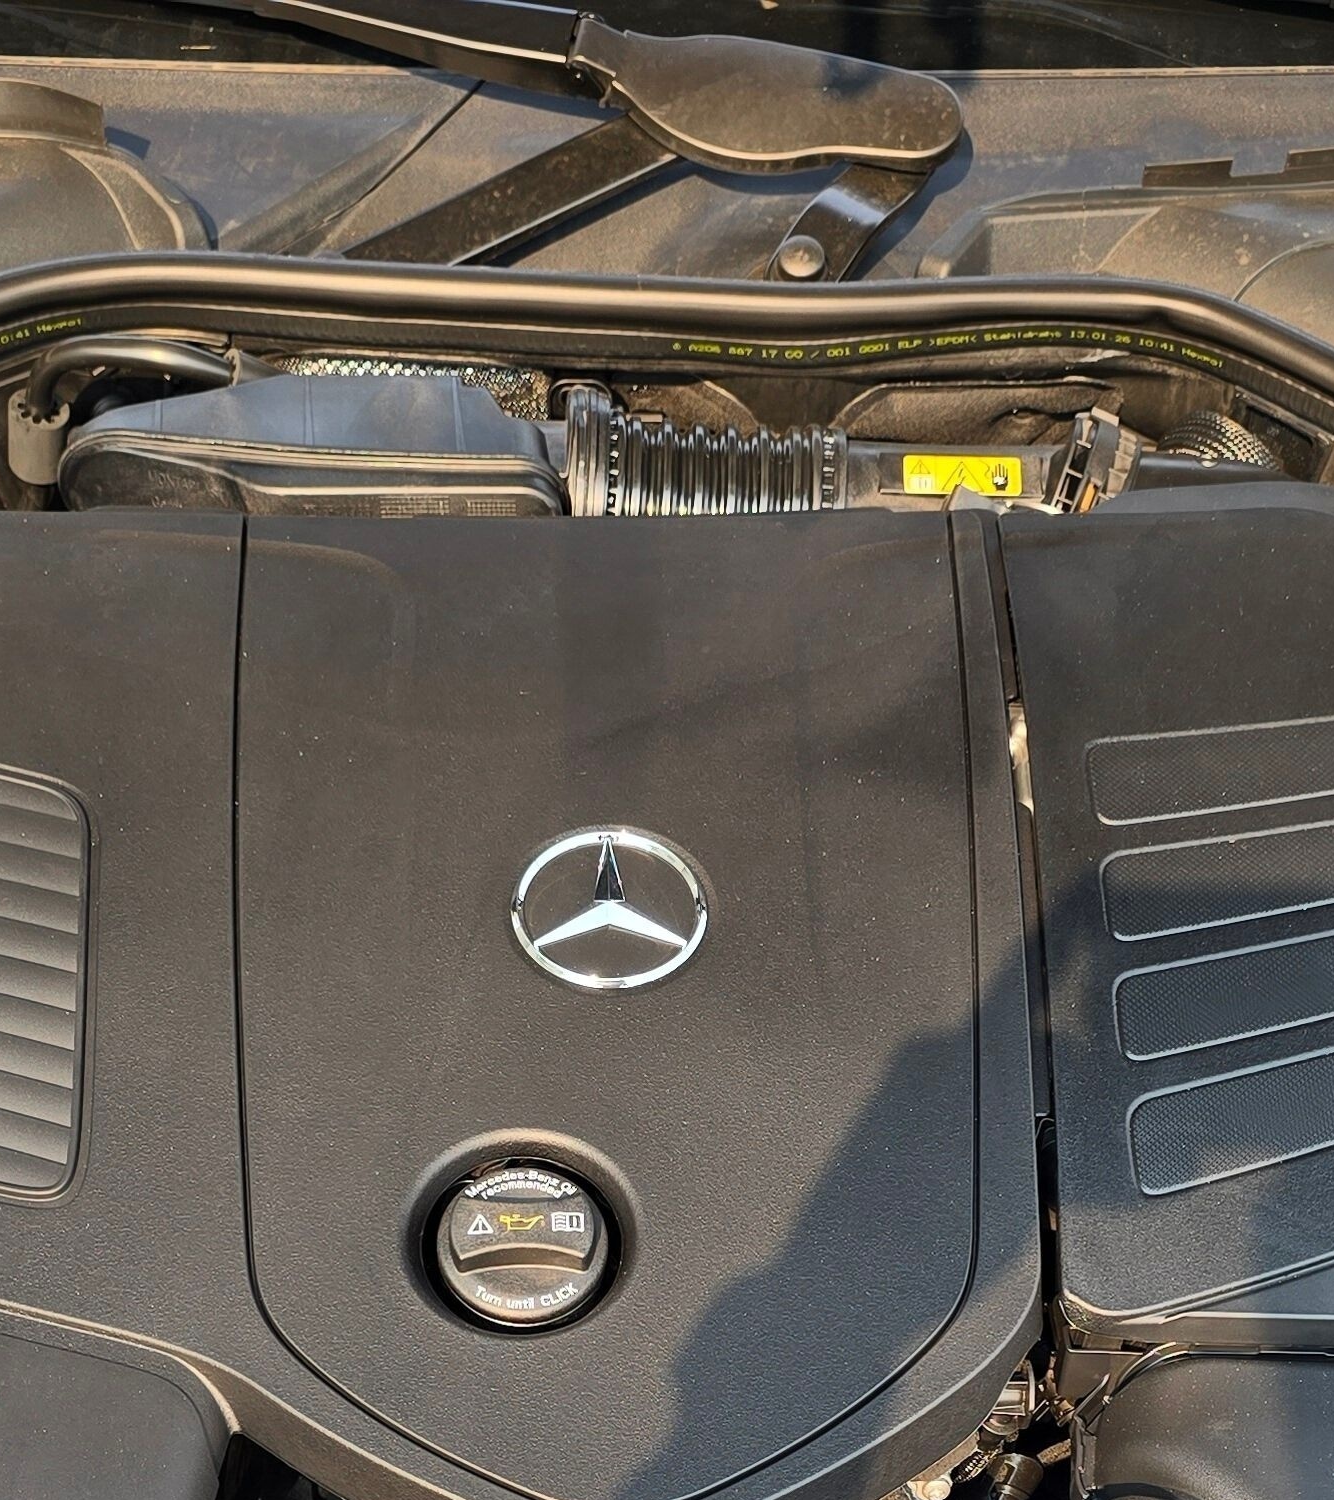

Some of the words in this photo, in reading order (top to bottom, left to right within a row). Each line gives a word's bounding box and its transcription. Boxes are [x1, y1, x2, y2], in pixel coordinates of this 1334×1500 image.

[761, 349, 778, 359] 17
[1138, 336, 1175, 352] 10:41
[464, 1170, 560, 1199] Mercedes-Benz
[480, 1180, 565, 1200] recommended
[475, 1284, 503, 1308] Turn
[506, 1297, 536, 1310] until
[540, 1282, 579, 1308] CLICK
